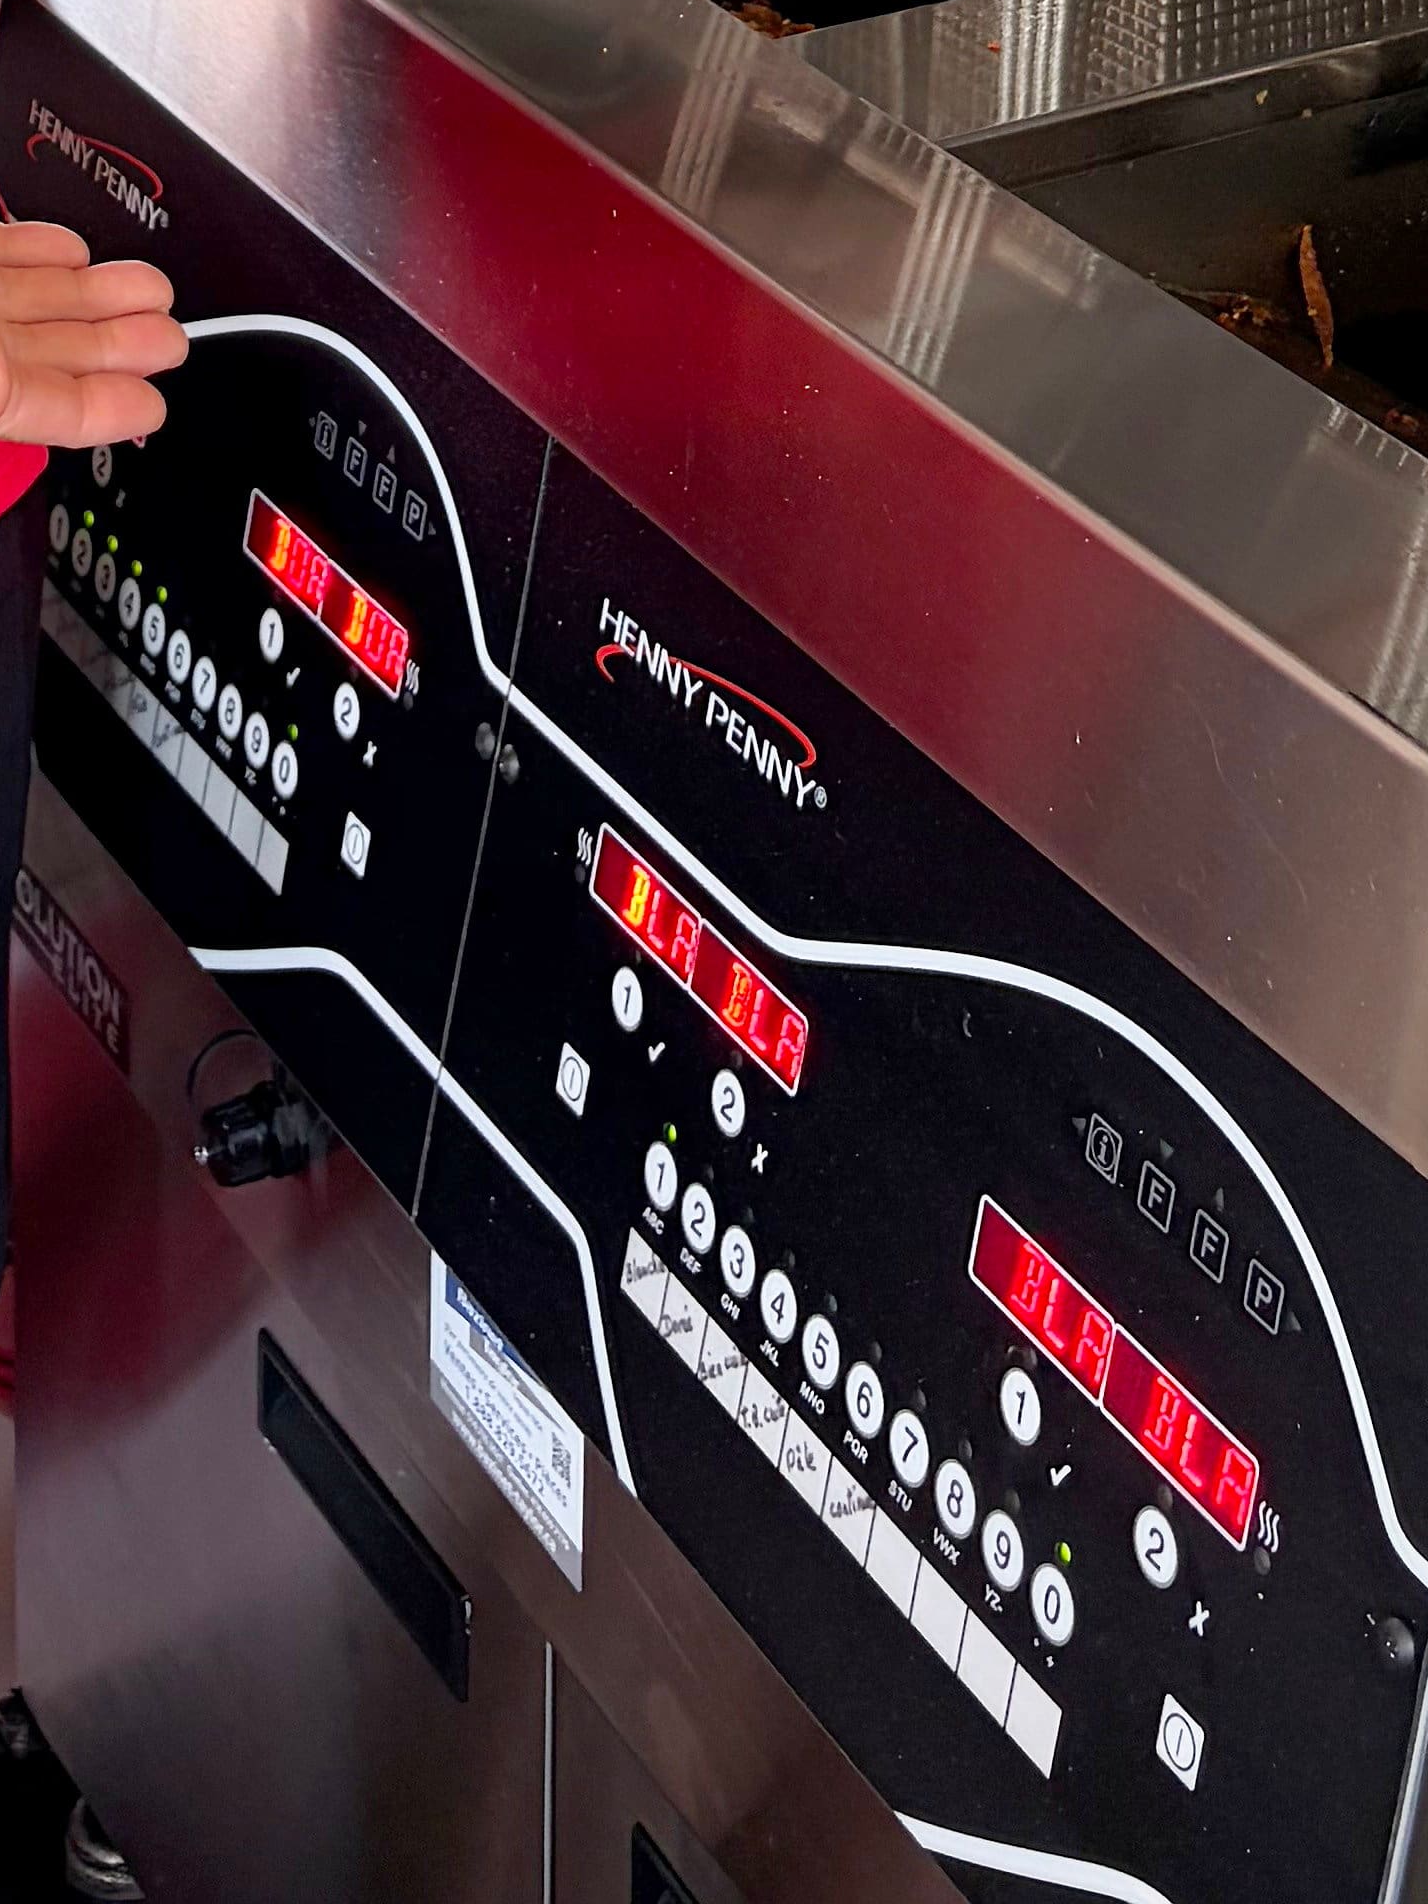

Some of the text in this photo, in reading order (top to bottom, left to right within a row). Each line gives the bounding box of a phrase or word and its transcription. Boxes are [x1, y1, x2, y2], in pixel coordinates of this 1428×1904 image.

[28, 99, 95, 170] HENNY
[599, 597, 704, 708] HENNY
[14, 868, 121, 1026] OLUTION
[691, 1201, 706, 1238] 2
[730, 1243, 744, 1279] 3
[770, 1292, 785, 1325] 4
[812, 1332, 830, 1370] 5
[857, 1380, 872, 1419] 6
[903, 1426, 919, 1463] 7
[947, 1478, 963, 1519] 8
[994, 1530, 1011, 1569] 9
[1044, 1584, 1061, 1625] 0
[799, 1381, 825, 1415] MNO
[842, 1429, 869, 1465] PQR
[887, 1479, 913, 1512] STU
[1145, 1527, 1165, 1572] 2
